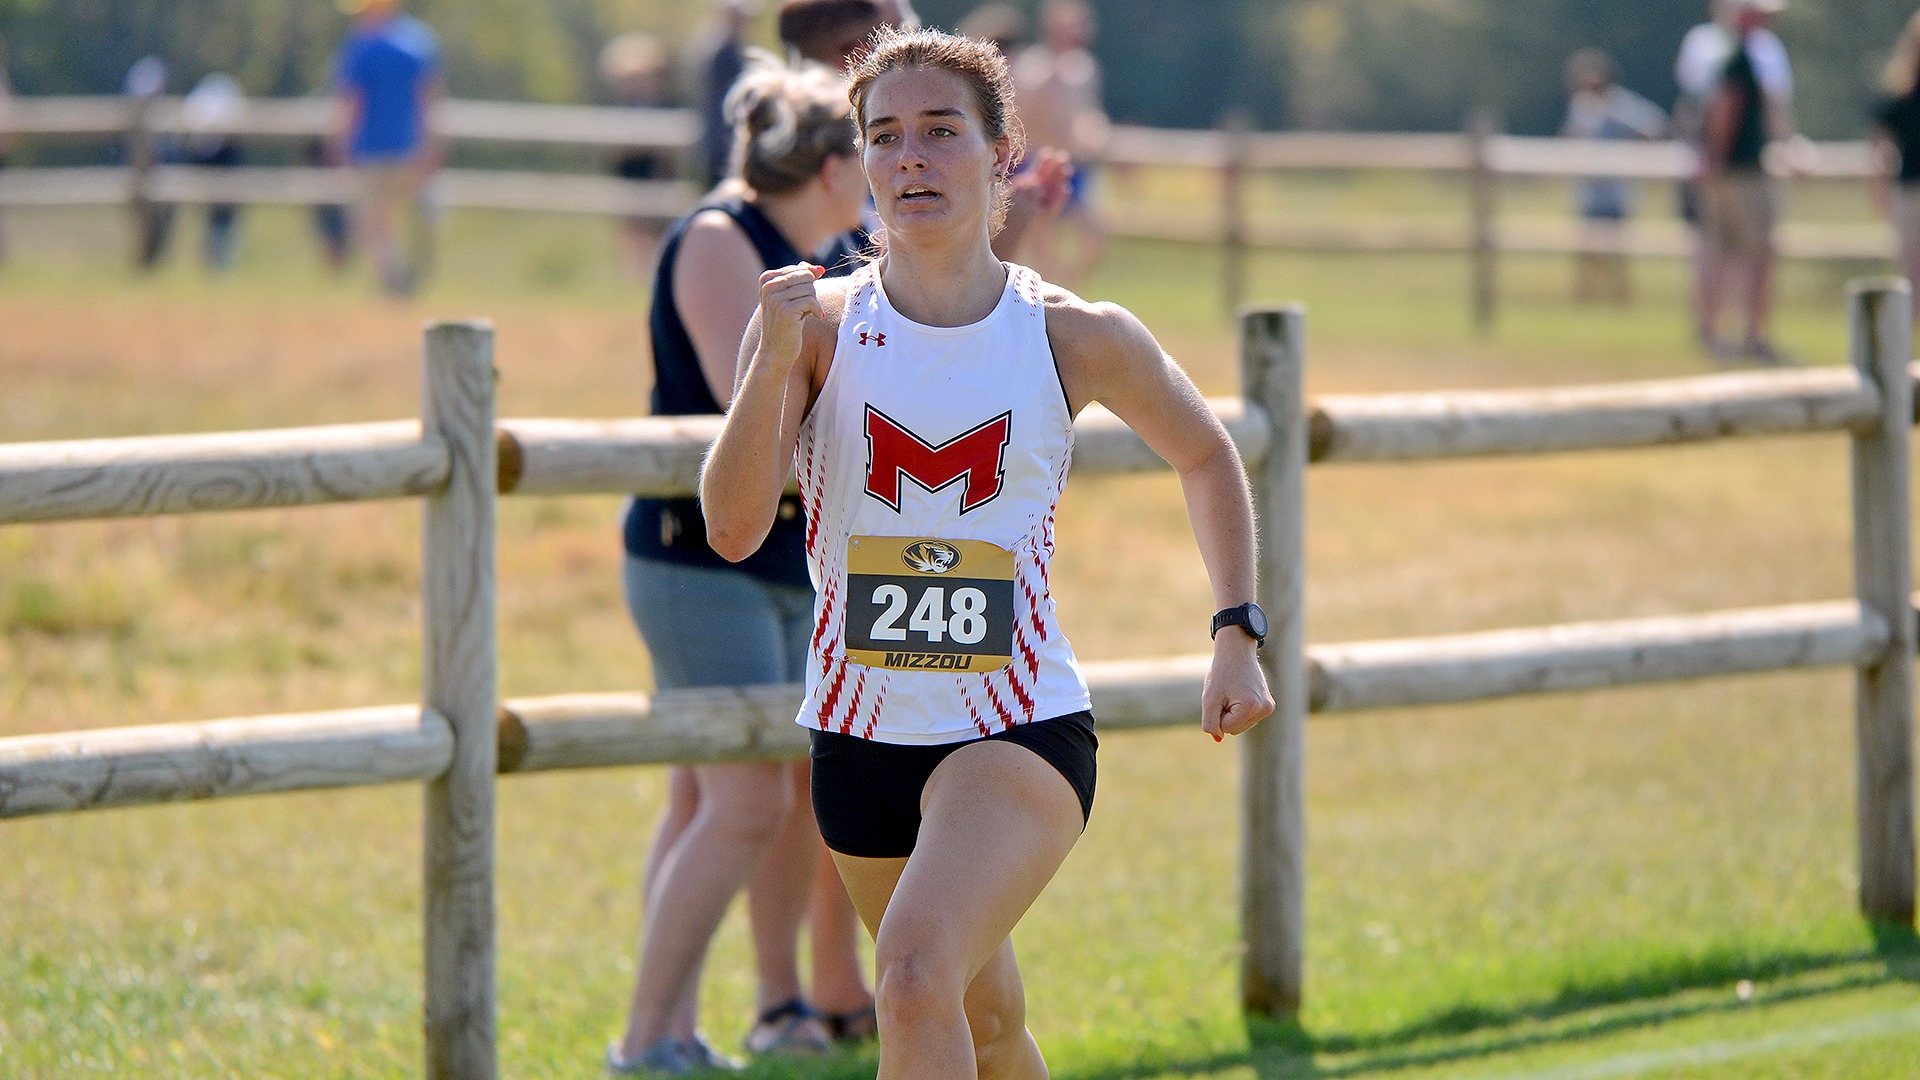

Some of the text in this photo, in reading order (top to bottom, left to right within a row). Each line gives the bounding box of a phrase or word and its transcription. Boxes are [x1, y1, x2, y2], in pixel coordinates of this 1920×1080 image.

[863, 402, 1012, 516] M
[869, 584, 988, 645] 248
[884, 652, 972, 670] MIZZOU
